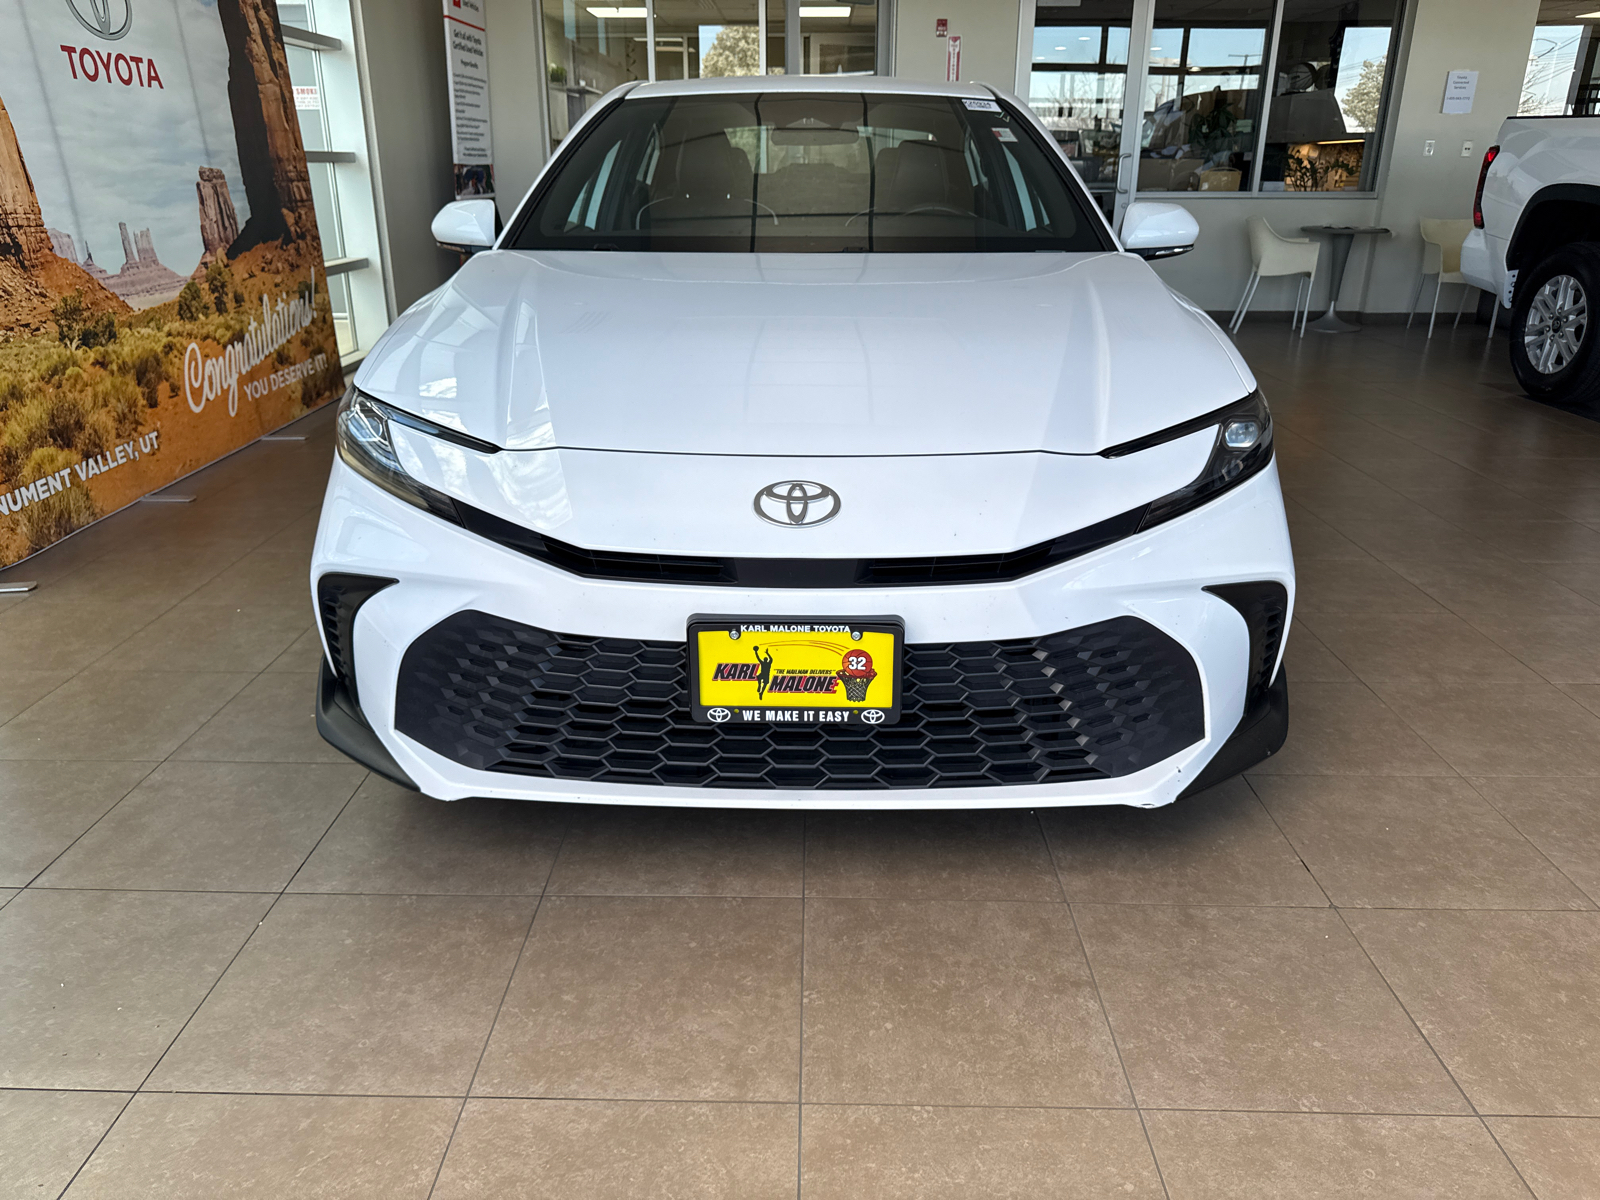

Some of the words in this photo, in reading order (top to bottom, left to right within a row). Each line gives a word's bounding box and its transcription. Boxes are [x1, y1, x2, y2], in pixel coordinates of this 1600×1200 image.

[60, 45, 164, 89] TOYOTA
[184, 266, 317, 417] Congratulations!
[243, 376, 269, 401] YOU
[270, 359, 315, 391] DESERVE
[314, 352, 329, 372] IT!
[74, 440, 140, 482] VALLEY,
[139, 431, 159, 454] UT
[740, 624, 768, 632] KARL
[813, 625, 851, 633] TOYOTA
[711, 663, 760, 682] KARL
[848, 656, 867, 670] 32
[767, 674, 840, 694] MALONE
[742, 710, 761, 721] WE
[765, 710, 799, 722] MAKE
[803, 710, 815, 722] IT
[819, 710, 850, 722] EASY
